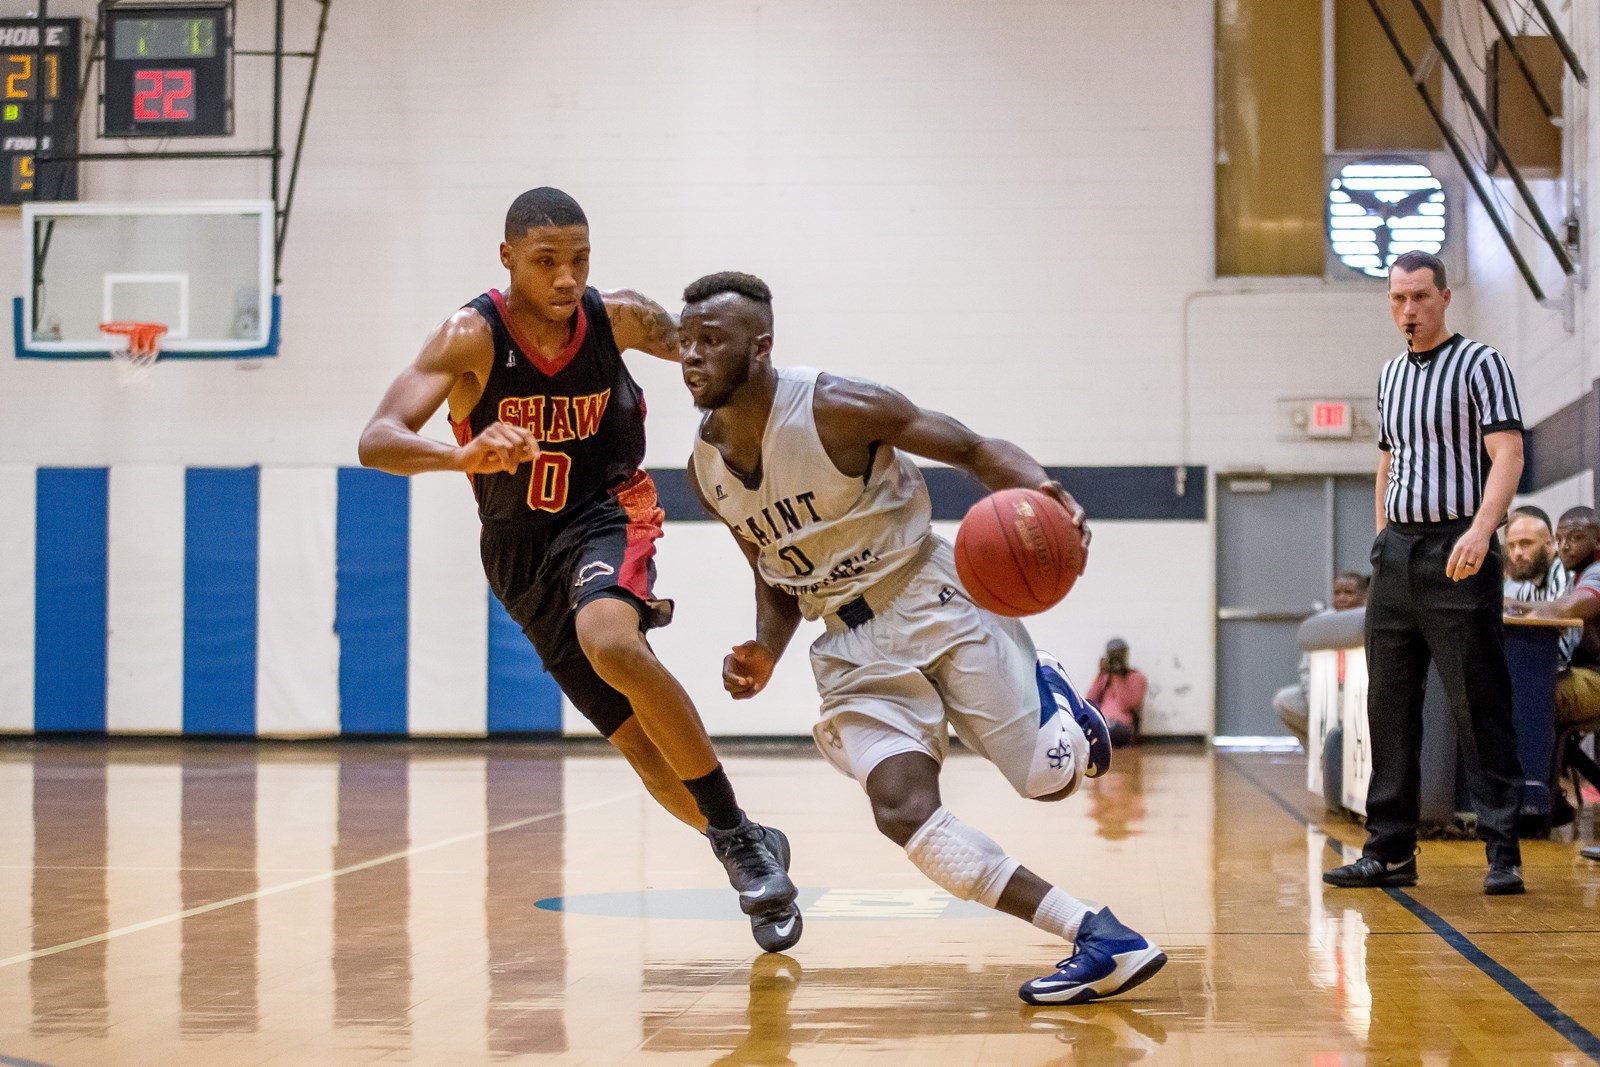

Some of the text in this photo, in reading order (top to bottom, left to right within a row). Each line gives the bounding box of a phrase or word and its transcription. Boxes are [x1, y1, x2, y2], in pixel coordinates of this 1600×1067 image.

[6, 54, 58, 98] 21
[133, 69, 193, 120] 22
[498, 388, 611, 442] SHAW
[527, 450, 572, 513] 0
[732, 491, 822, 547] AINT
